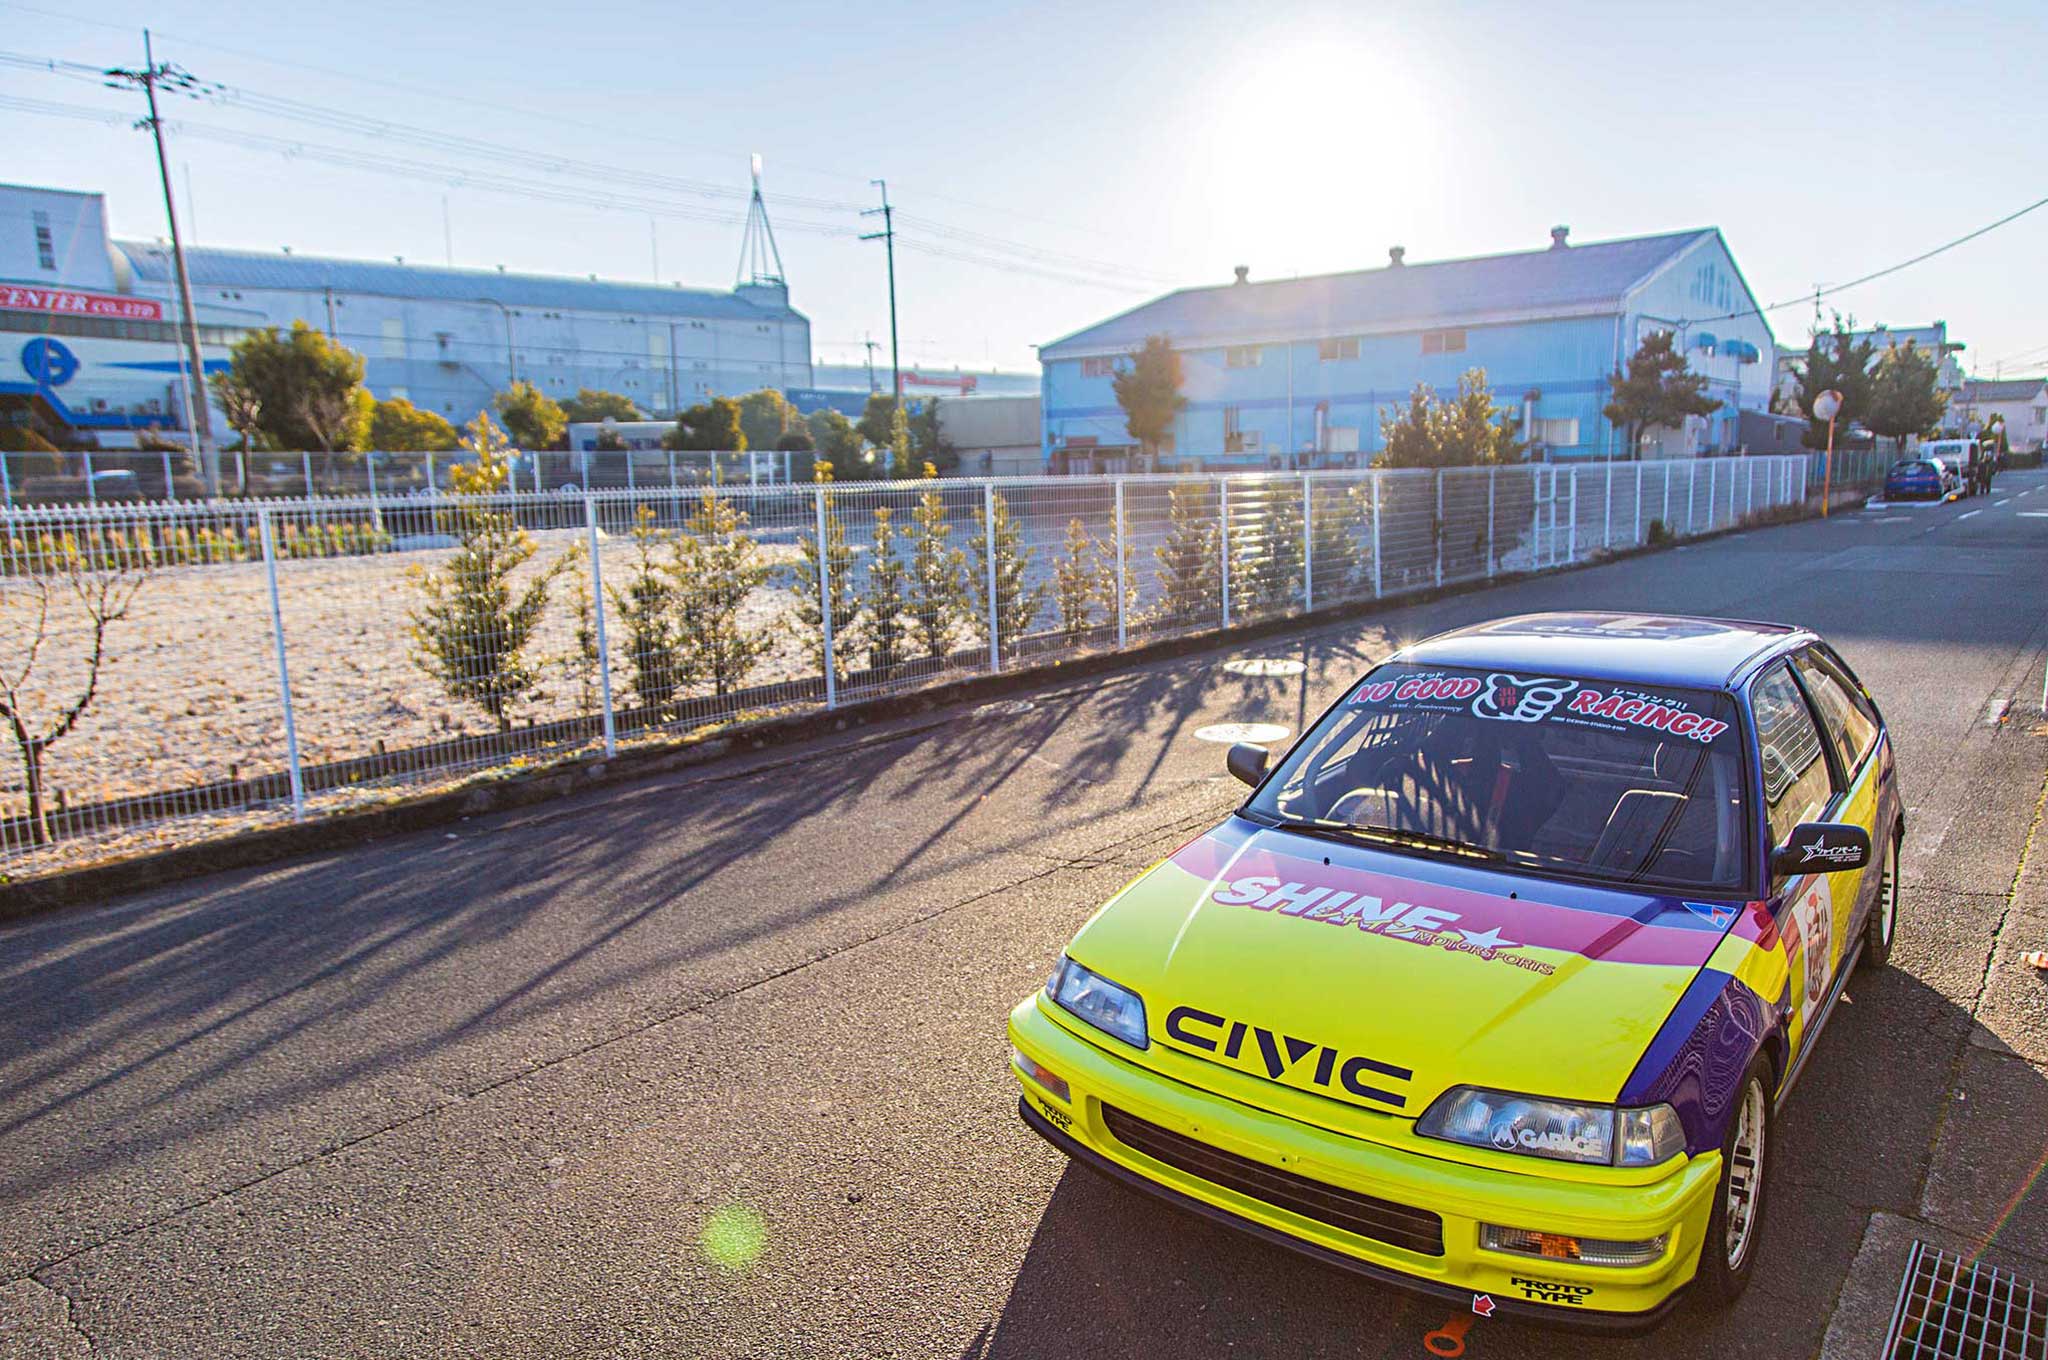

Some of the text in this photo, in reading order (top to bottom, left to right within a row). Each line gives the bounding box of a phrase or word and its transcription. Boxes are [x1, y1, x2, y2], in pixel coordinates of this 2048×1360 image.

[1348, 680, 1398, 705] NO
[1395, 677, 1482, 701] GOOD
[1567, 689, 1729, 743] RACING!!
[1211, 876, 1463, 947] SHINE
[1414, 929, 1557, 977] MOTORSPORTS
[1165, 1005, 1414, 1109] CIVIC
[1518, 1128, 1603, 1157] GARAGE
[1511, 1276, 1594, 1296] PROTO
[1519, 1287, 1584, 1305] TYPE
